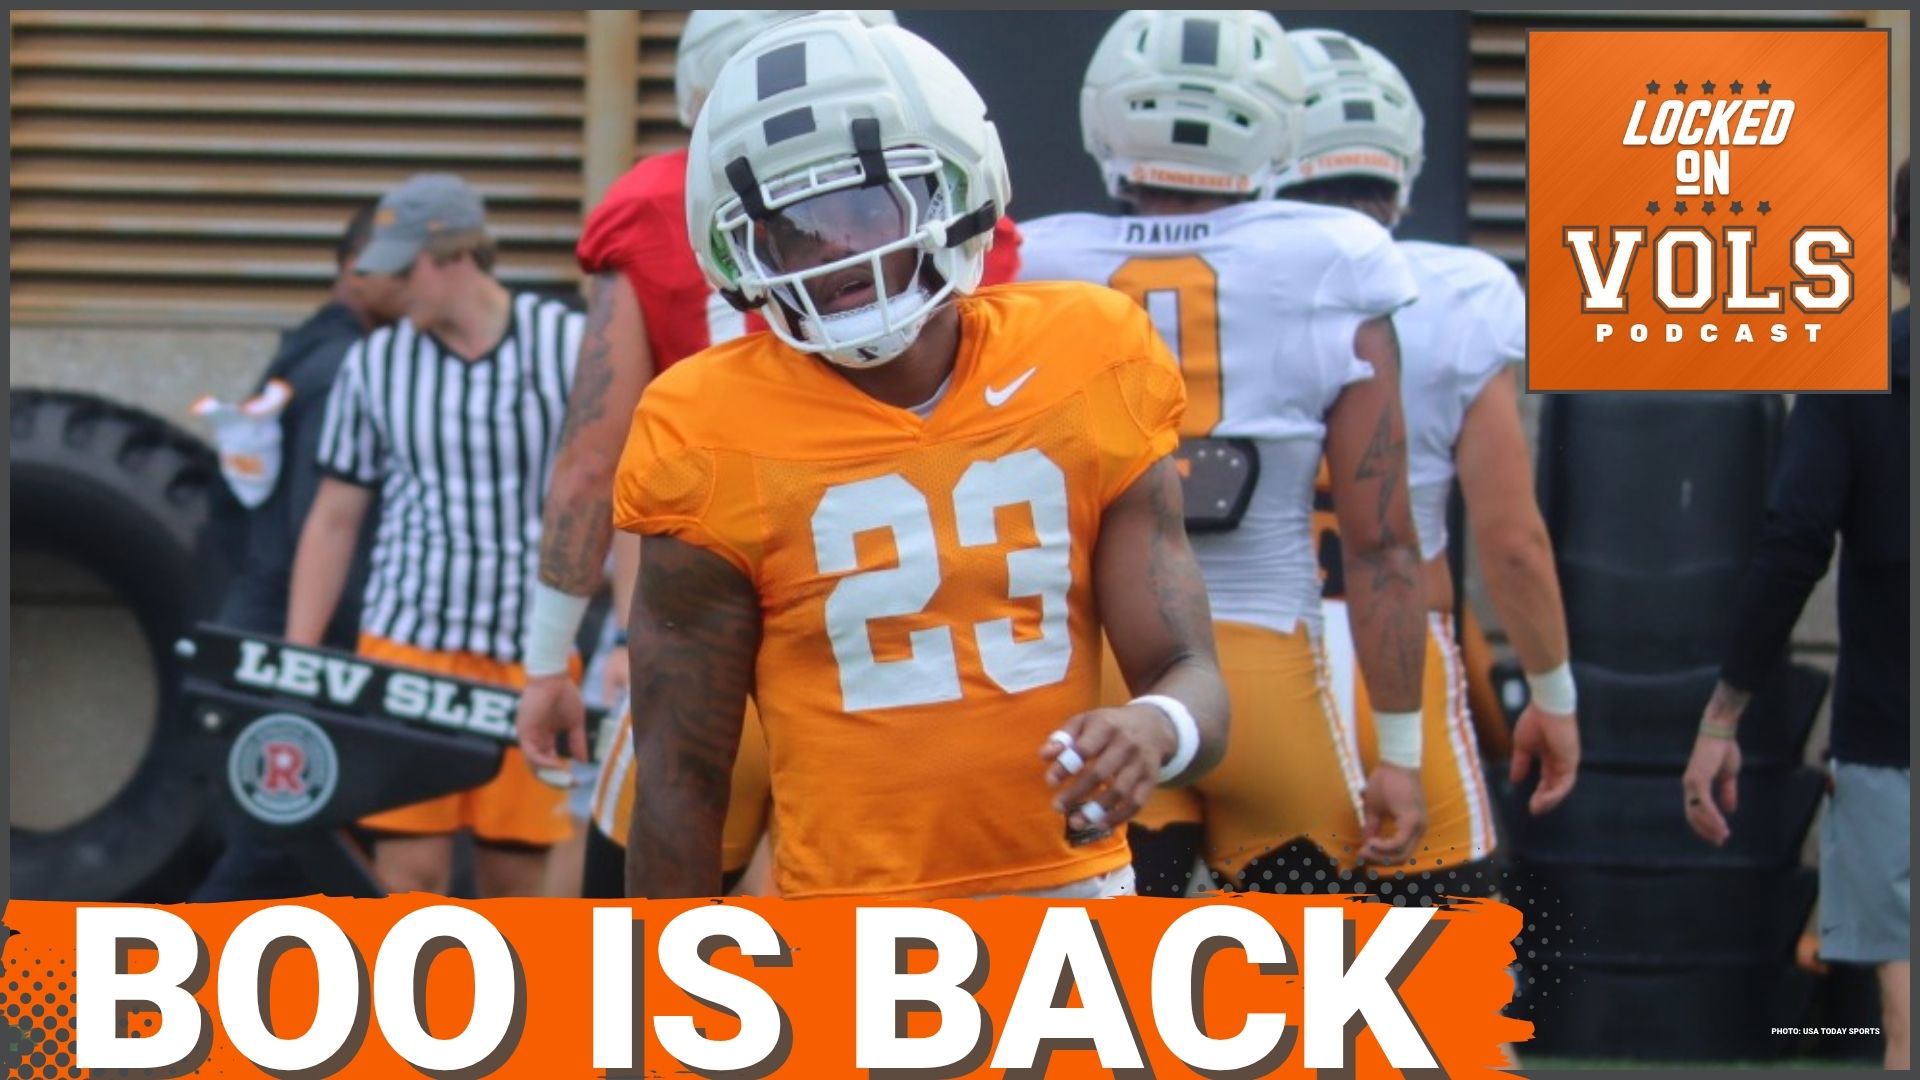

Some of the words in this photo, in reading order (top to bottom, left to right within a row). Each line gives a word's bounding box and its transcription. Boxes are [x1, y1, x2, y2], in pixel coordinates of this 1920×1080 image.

[811, 447, 1072, 712] 23
[235, 640, 372, 703] LEV
[384, 672, 520, 739] SLE
[264, 741, 306, 796] R
